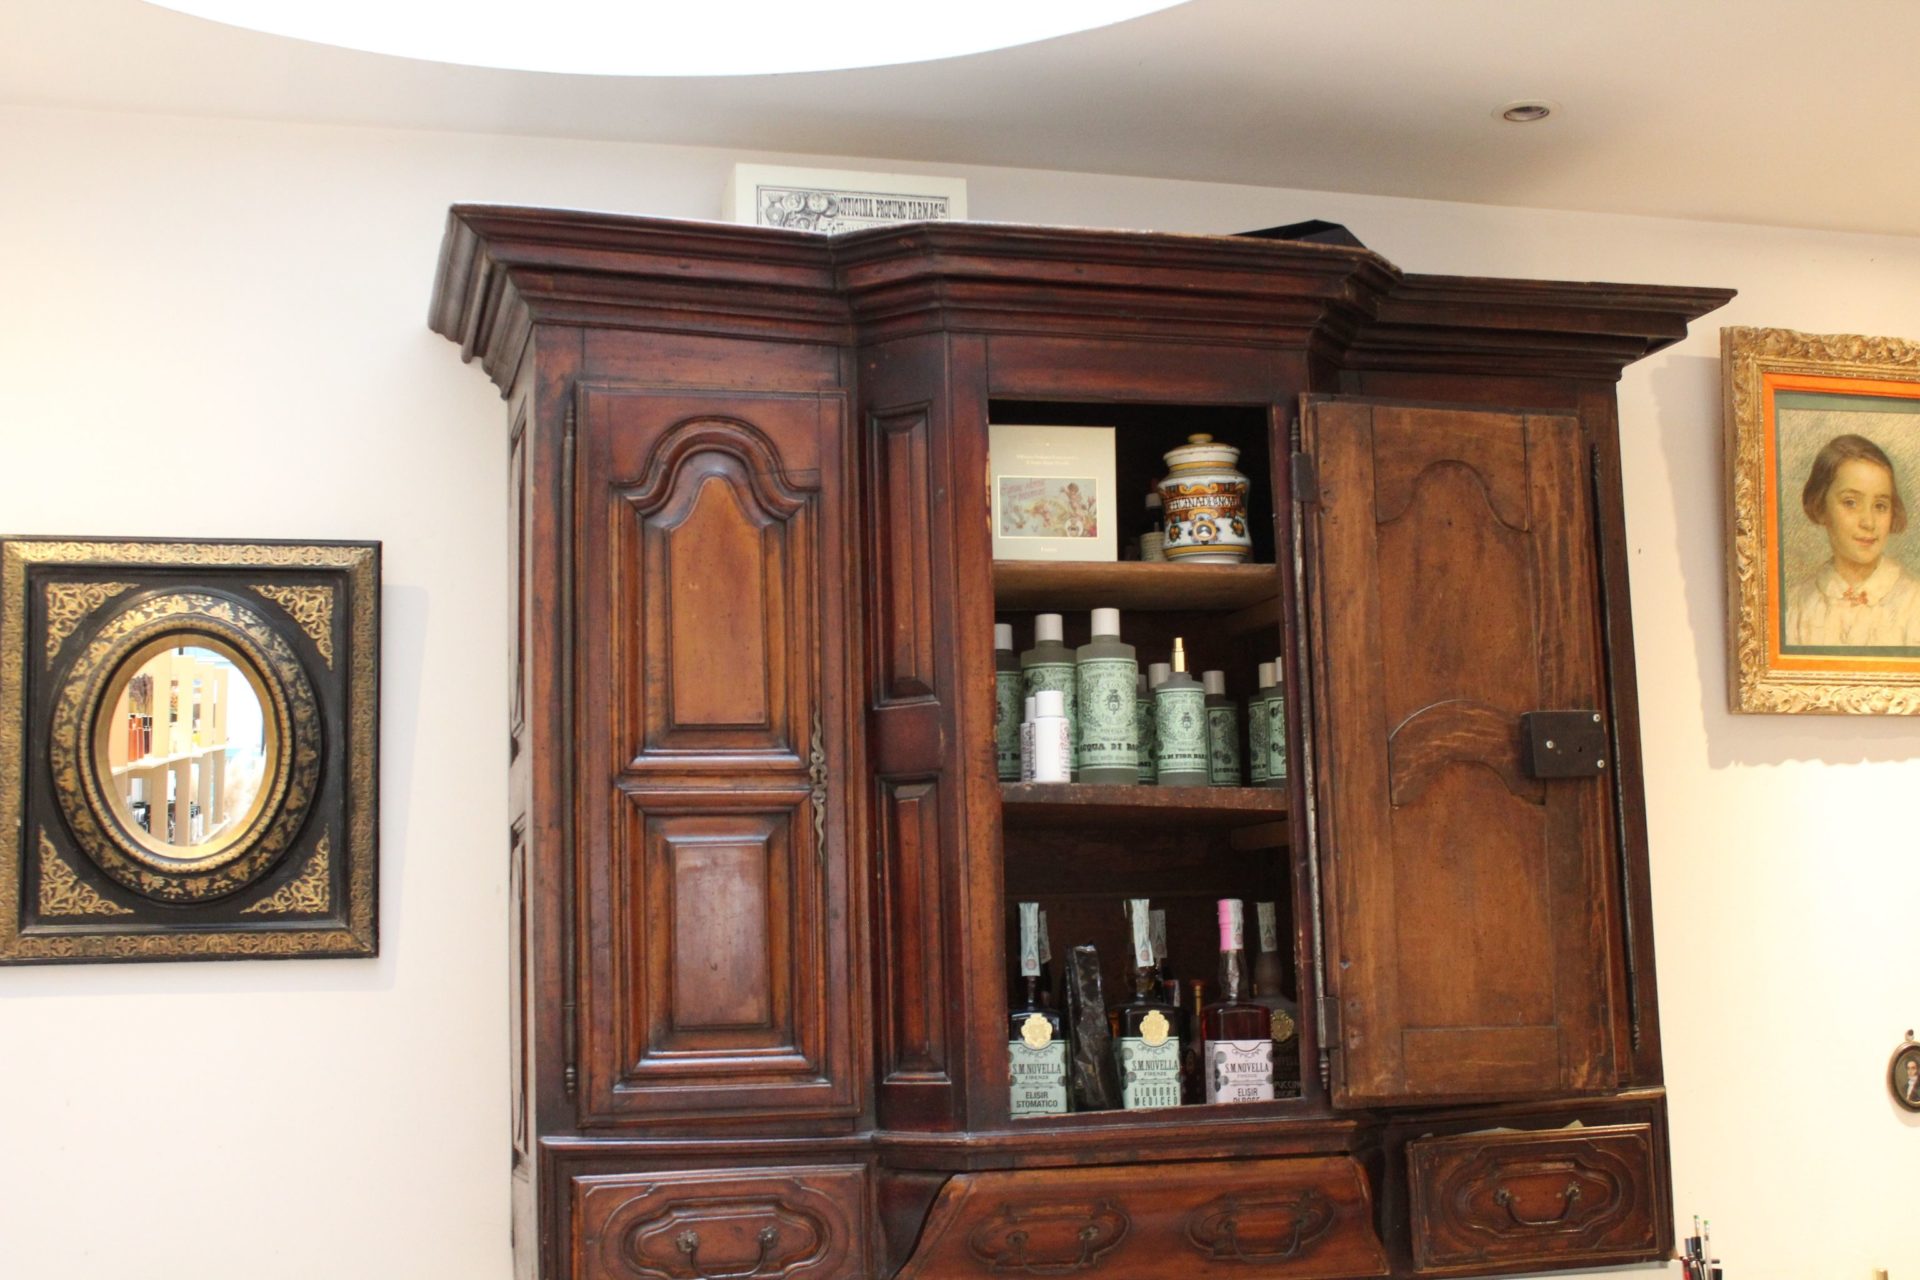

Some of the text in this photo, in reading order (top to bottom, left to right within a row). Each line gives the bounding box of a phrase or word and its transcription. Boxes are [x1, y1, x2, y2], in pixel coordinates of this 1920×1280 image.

[839, 197, 874, 218] OFFICINA
[876, 199, 906, 220] PROFUMO
[1025, 1091, 1048, 1099] ELISIR
[1134, 1086, 1177, 1097] LIQUORE
[1237, 1087, 1258, 1097] ELISIR
[1016, 1099, 1058, 1108] STOMATICO
[1134, 1096, 1178, 1106] MEDICEO
